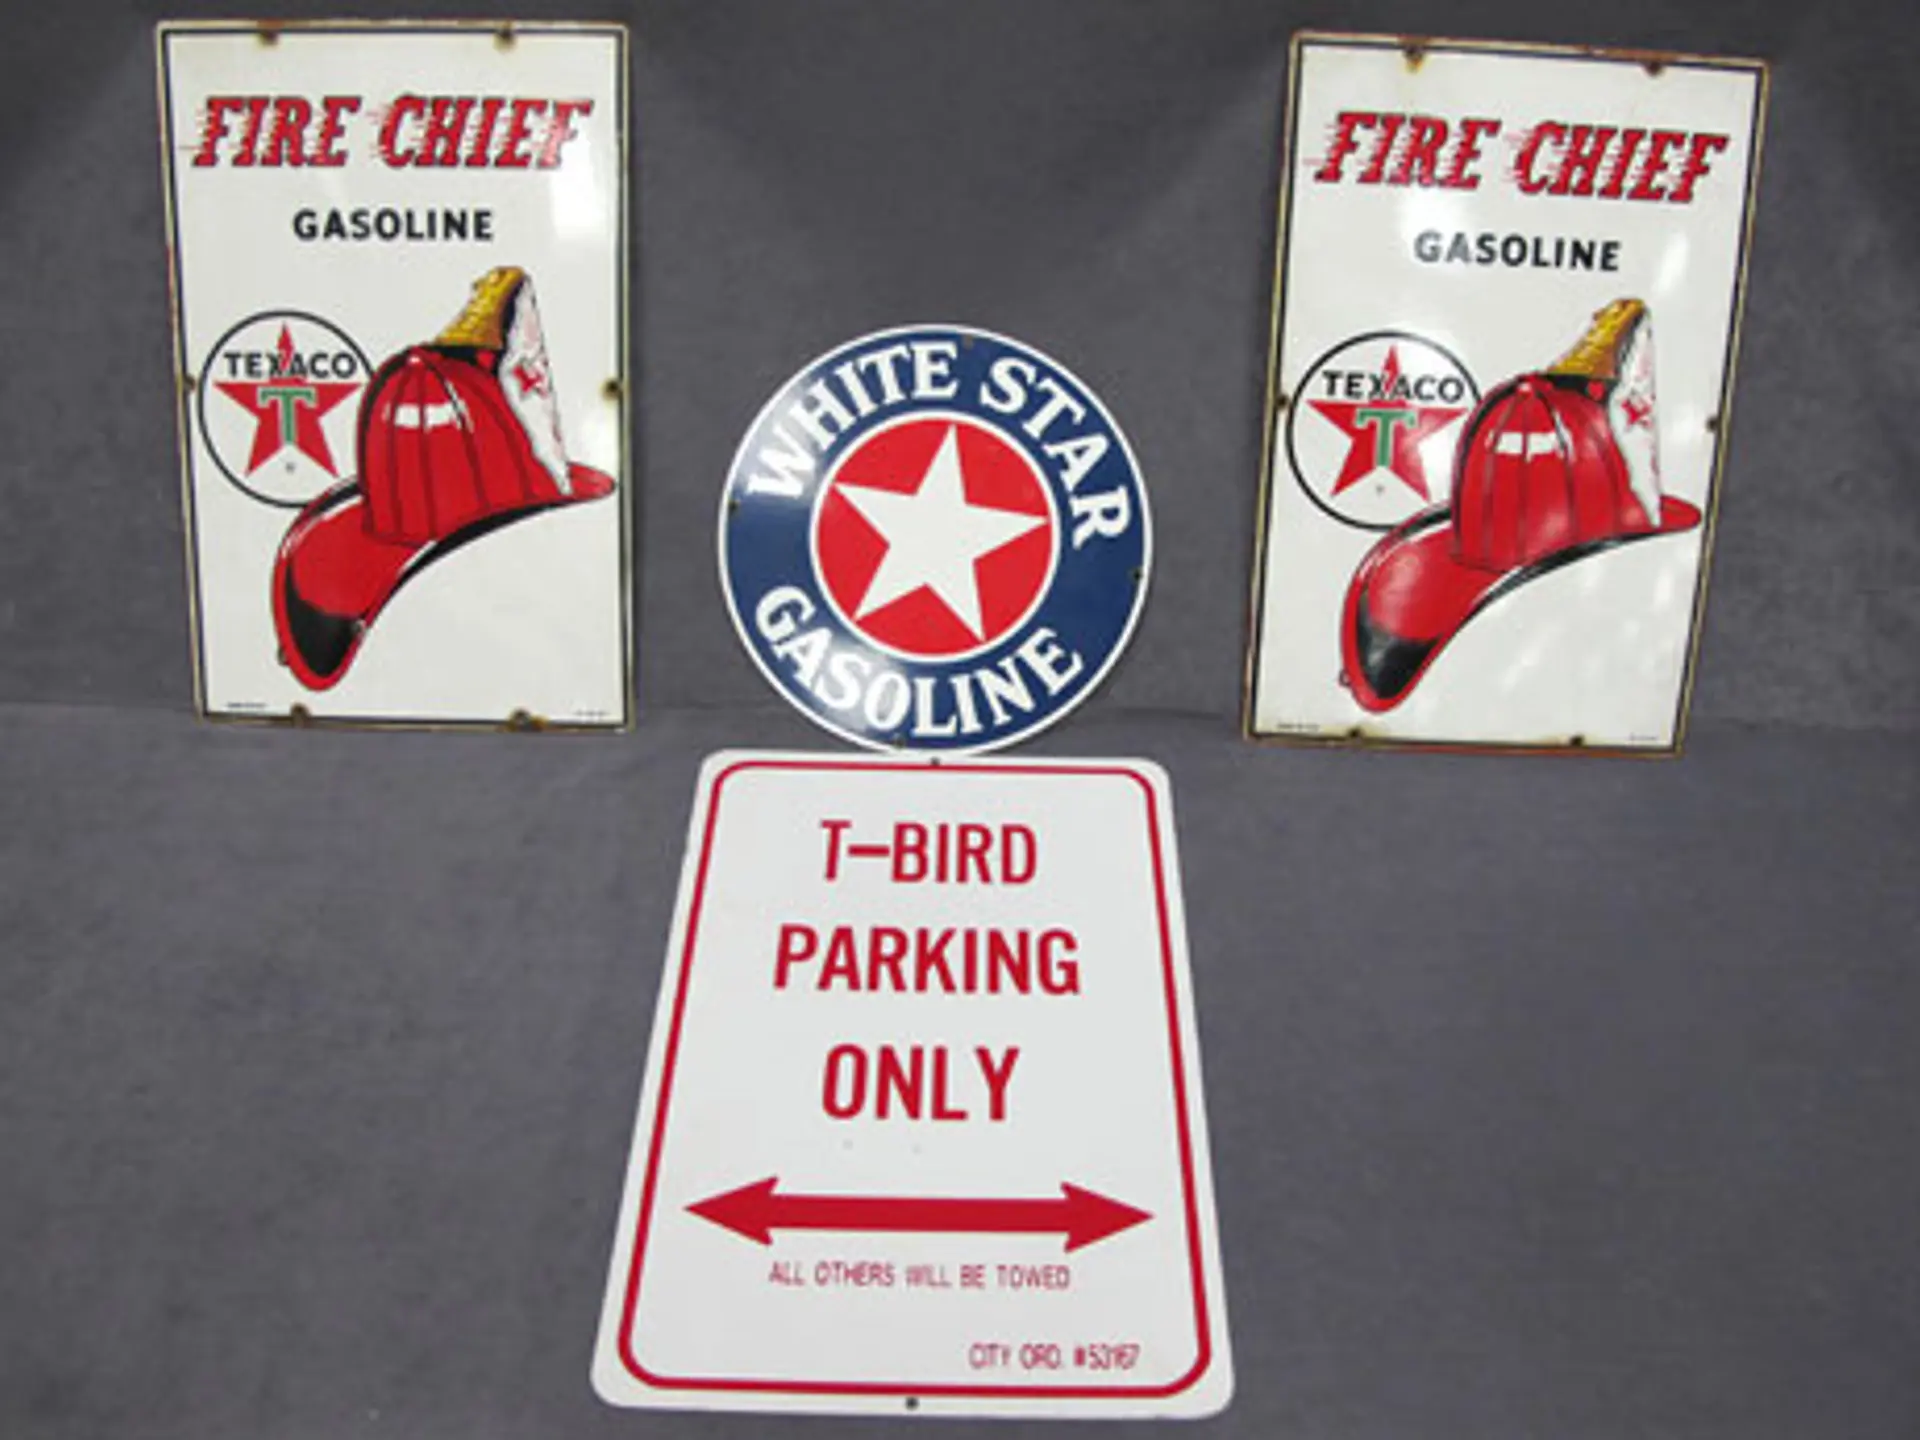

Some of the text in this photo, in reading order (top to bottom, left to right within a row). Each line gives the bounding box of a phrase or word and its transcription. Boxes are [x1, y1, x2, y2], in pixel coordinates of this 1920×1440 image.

[192, 95, 594, 169] FIRE CHIEF
[1313, 111, 1731, 204] FIRE CHIEF
[293, 207, 495, 243] GASOLINE
[1413, 229, 1622, 272] GASOLINE
[223, 351, 359, 379] TEXACO
[1322, 369, 1466, 404] TEXACO
[256, 386, 317, 446] T
[747, 341, 1131, 549] WHITE STAR
[1355, 407, 1417, 468] T
[755, 586, 1084, 738] GASOLINE
[820, 819, 1039, 885] T-BIRD
[773, 923, 1081, 996] PARKING
[821, 1043, 1020, 1121] ONLY
[768, 1260, 1071, 1291] ALL OTHERS WILL BE TOWED
[968, 1342, 1011, 1370] CITY
